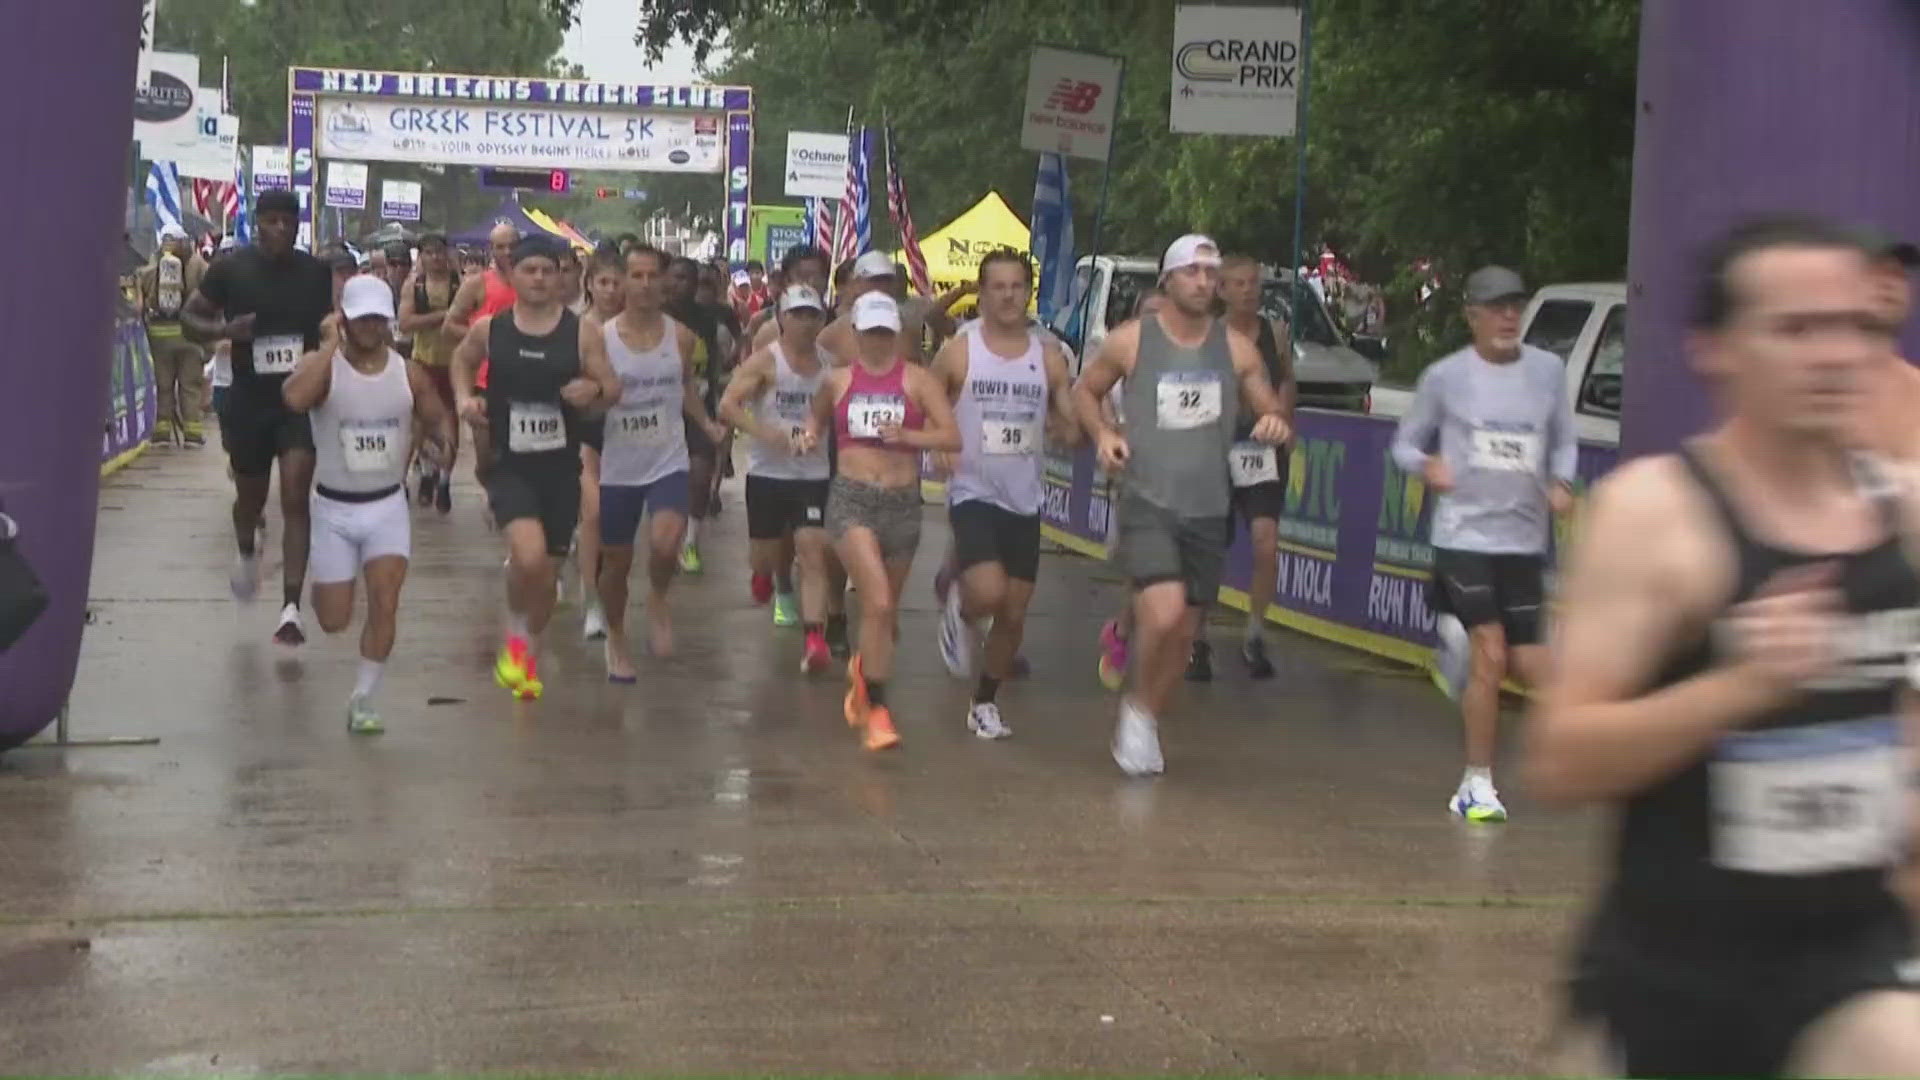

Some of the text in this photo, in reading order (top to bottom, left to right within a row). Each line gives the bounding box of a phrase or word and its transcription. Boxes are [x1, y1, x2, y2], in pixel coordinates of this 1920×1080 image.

[1206, 39, 1297, 62] GRAND
[1240, 65, 1296, 88] PRIX
[323, 69, 725, 109] NEW ORLEANS TRACK CLUB
[389, 107, 470, 134] GREEK
[485, 110, 610, 139] FESTIVAL
[624, 116, 654, 142] 5K
[441, 140, 471, 154] YOUR
[476, 142, 526, 156] ODYSSEY
[531, 145, 571, 157] BEGINS
[798, 149, 847, 163] Ochsner
[265, 349, 294, 364] 913
[971, 380, 1042, 398] POWER MILER
[1180, 389, 1200, 409] 32
[518, 416, 559, 434] 1109
[1001, 427, 1022, 445] 35
[1292, 556, 1333, 608] NOLA
[1367, 574, 1406, 625] RUN
